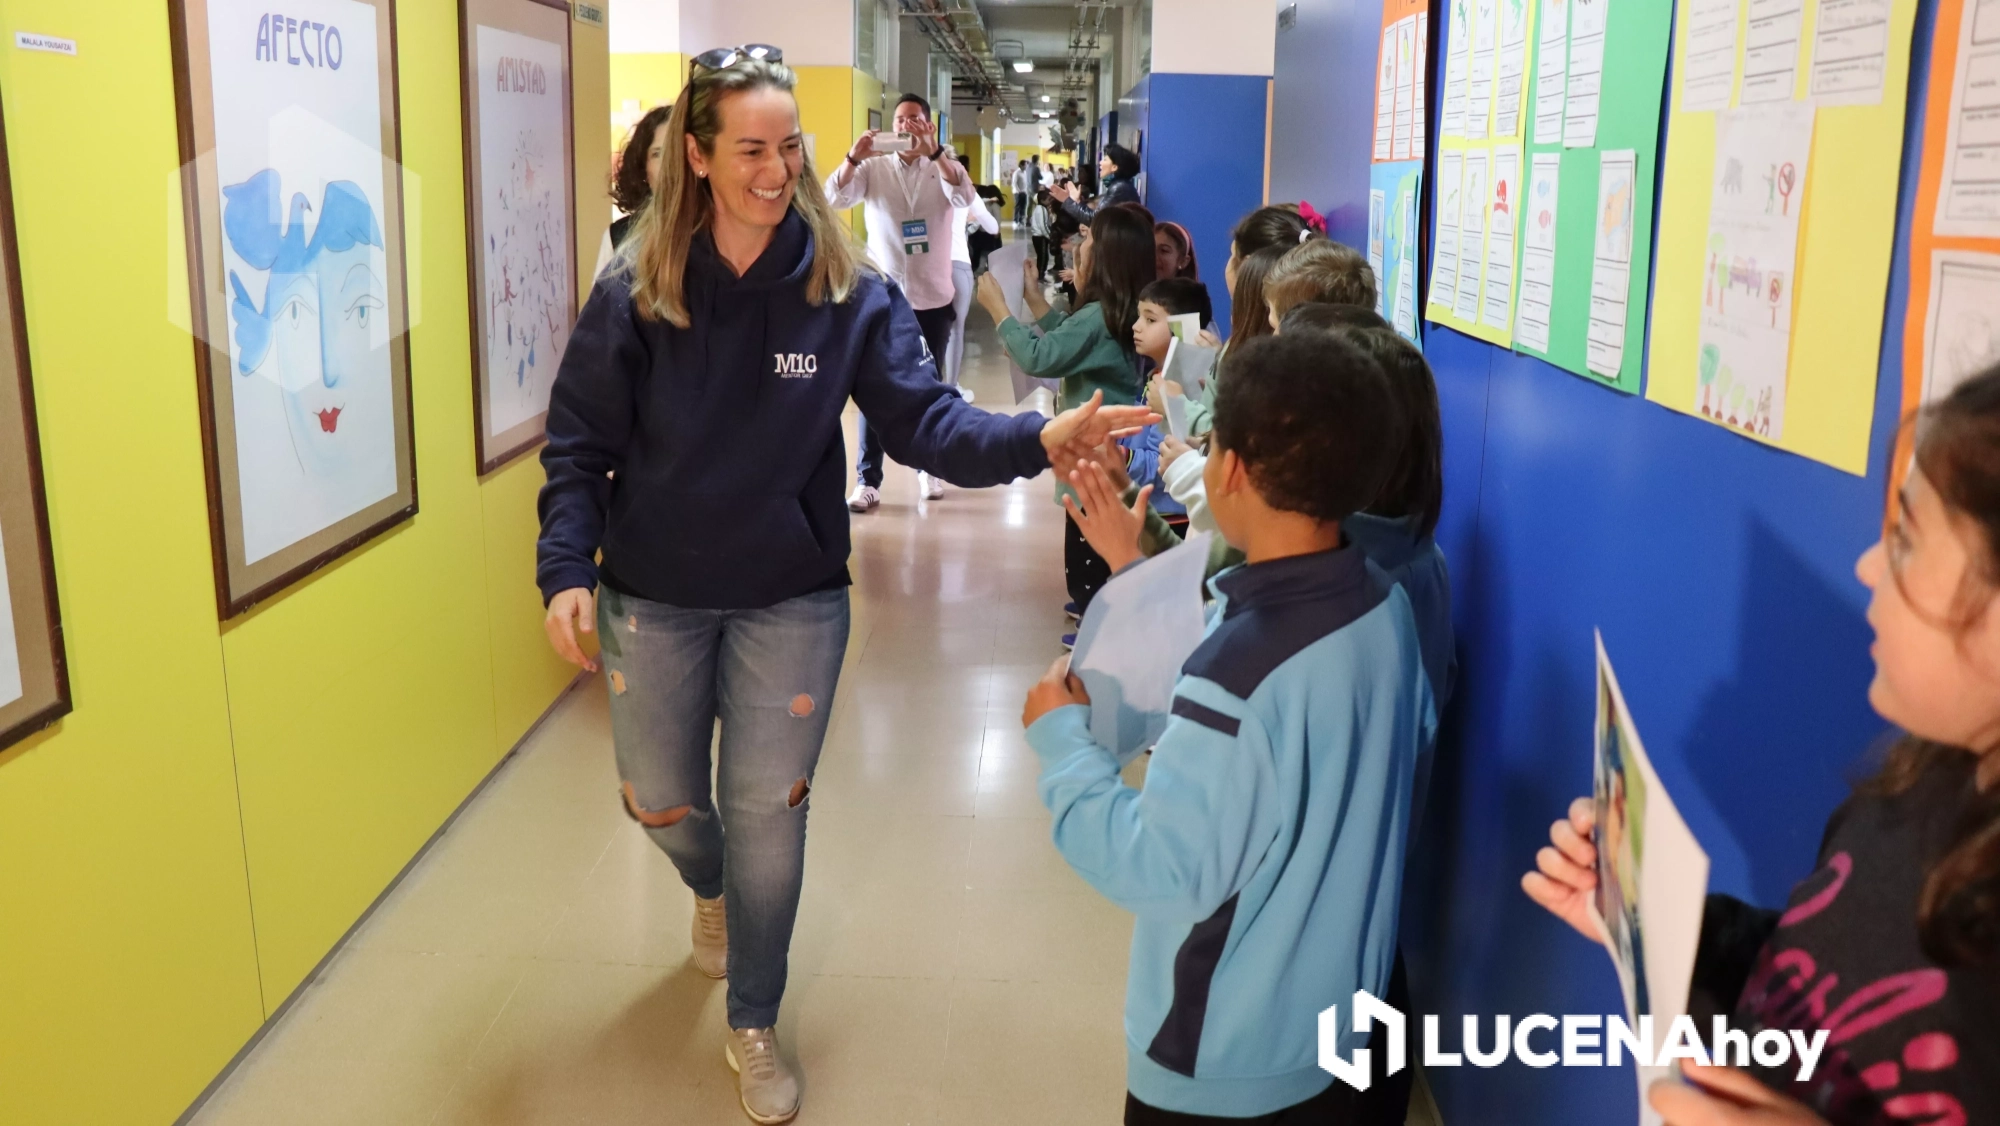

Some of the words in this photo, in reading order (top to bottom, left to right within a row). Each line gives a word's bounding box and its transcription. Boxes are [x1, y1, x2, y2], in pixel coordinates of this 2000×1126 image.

[21, 37, 43, 47] MALALA
[256, 13, 342, 70] AFECTO
[497, 56, 546, 95] AMISTAD
[774, 353, 817, 373] M10
